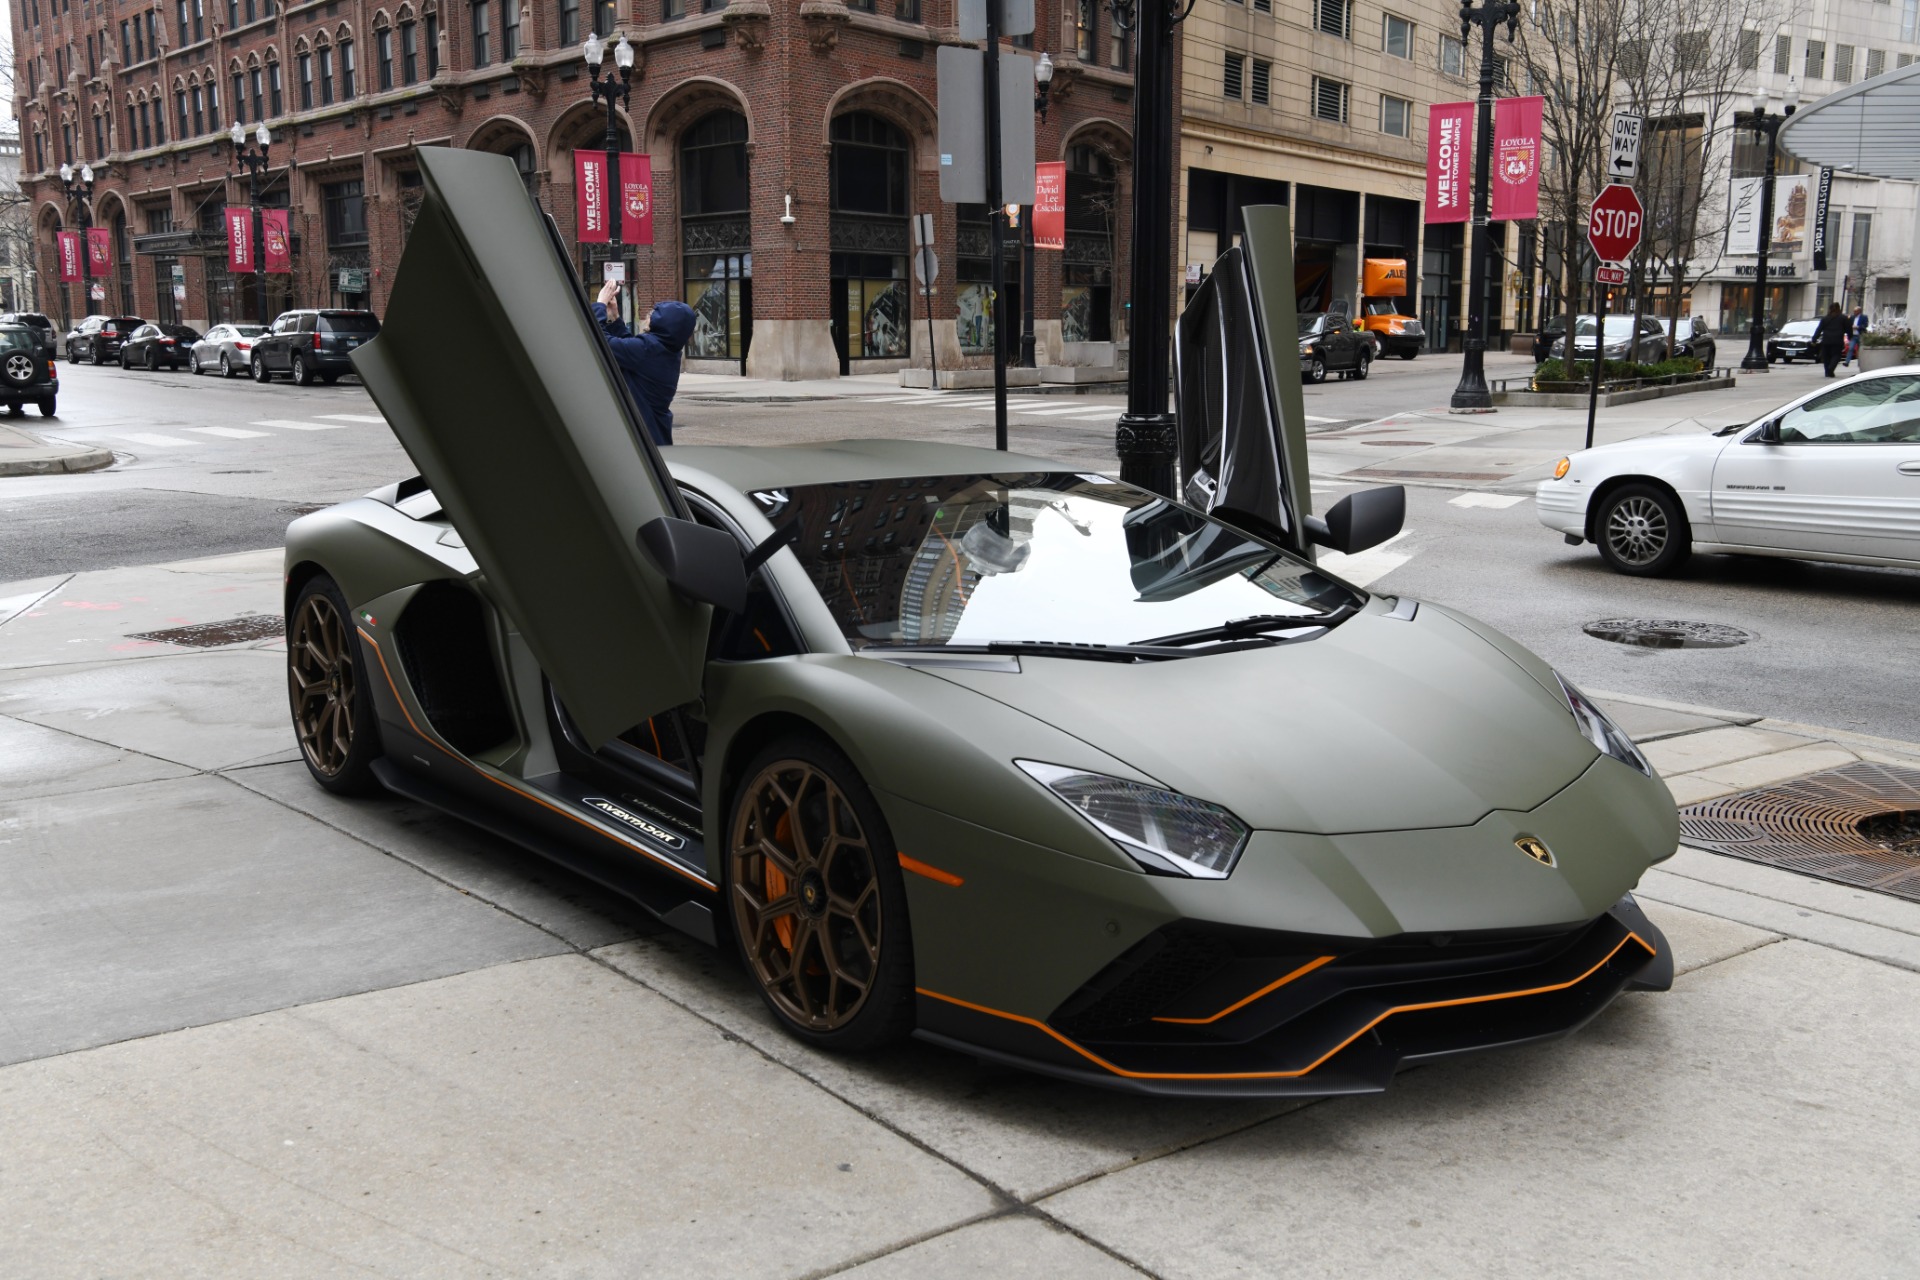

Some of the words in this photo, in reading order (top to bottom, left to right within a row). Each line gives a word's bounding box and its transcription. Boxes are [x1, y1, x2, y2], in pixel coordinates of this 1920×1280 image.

[1454, 118, 1462, 151] CAMPUS
[1616, 119, 1638, 136] ONE
[1500, 138, 1535, 147] LOYOLA
[1614, 136, 1636, 153] WAY
[1438, 118, 1453, 208] WELCOME
[584, 161, 596, 231] WELCOME
[1036, 185, 1059, 194] David
[1045, 194, 1059, 202] Lee
[1592, 207, 1639, 239] STOP
[232, 216, 244, 264] WELCOME
[1814, 227, 1825, 253] rack
[63, 238, 73, 276] WELCOME
[1778, 262, 1796, 276] rack
[1600, 270, 1610, 280] ALL
[596, 803, 676, 842] AVENTADOR
